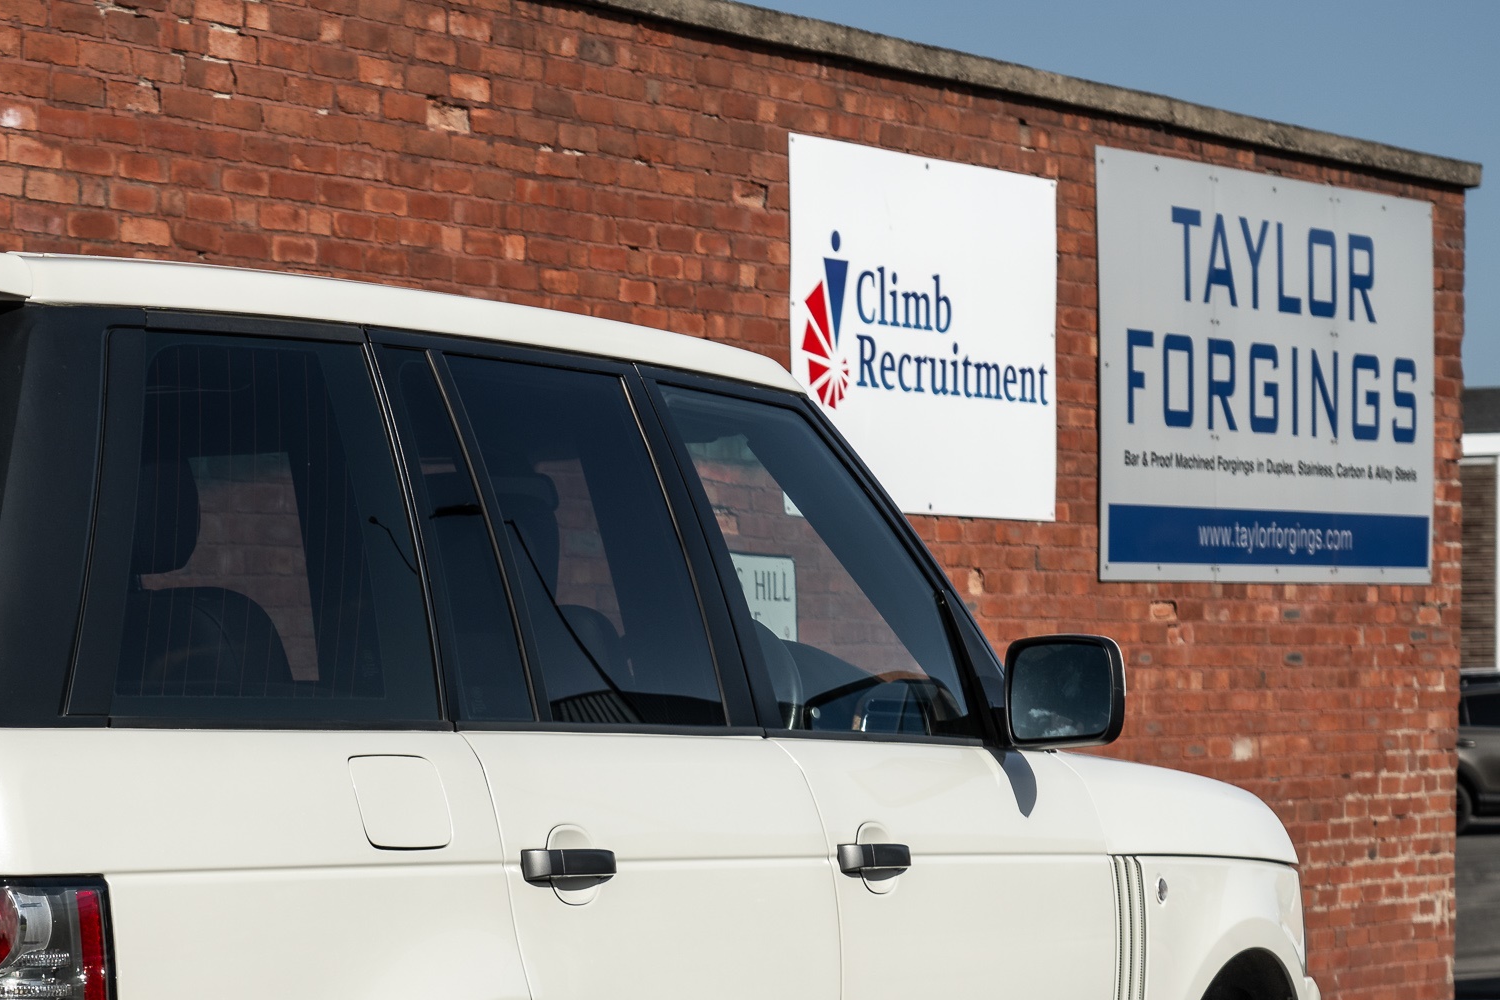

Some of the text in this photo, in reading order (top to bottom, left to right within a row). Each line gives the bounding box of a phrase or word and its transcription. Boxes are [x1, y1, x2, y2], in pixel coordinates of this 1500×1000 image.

[1171, 205, 1377, 324] TAYLOR
[856, 266, 952, 333] Climb
[856, 334, 1048, 406] Recruitment
[1127, 328, 1417, 443] FORGINGS
[1124, 449, 1140, 467] Bar
[1142, 451, 1149, 467] &
[1150, 451, 1173, 469] Proof
[1175, 452, 1215, 471] Machined
[1217, 455, 1255, 476] Forgings
[1256, 457, 1265, 473] in
[1266, 458, 1296, 478] Duplex,
[1336, 462, 1366, 479] Carbon
[1367, 464, 1374, 480] &
[1375, 464, 1393, 484] Alloy
[1395, 465, 1418, 483] Steels
[1198, 521, 1353, 555] www.taylorforgings.com
[754, 569, 791, 602] HILL
